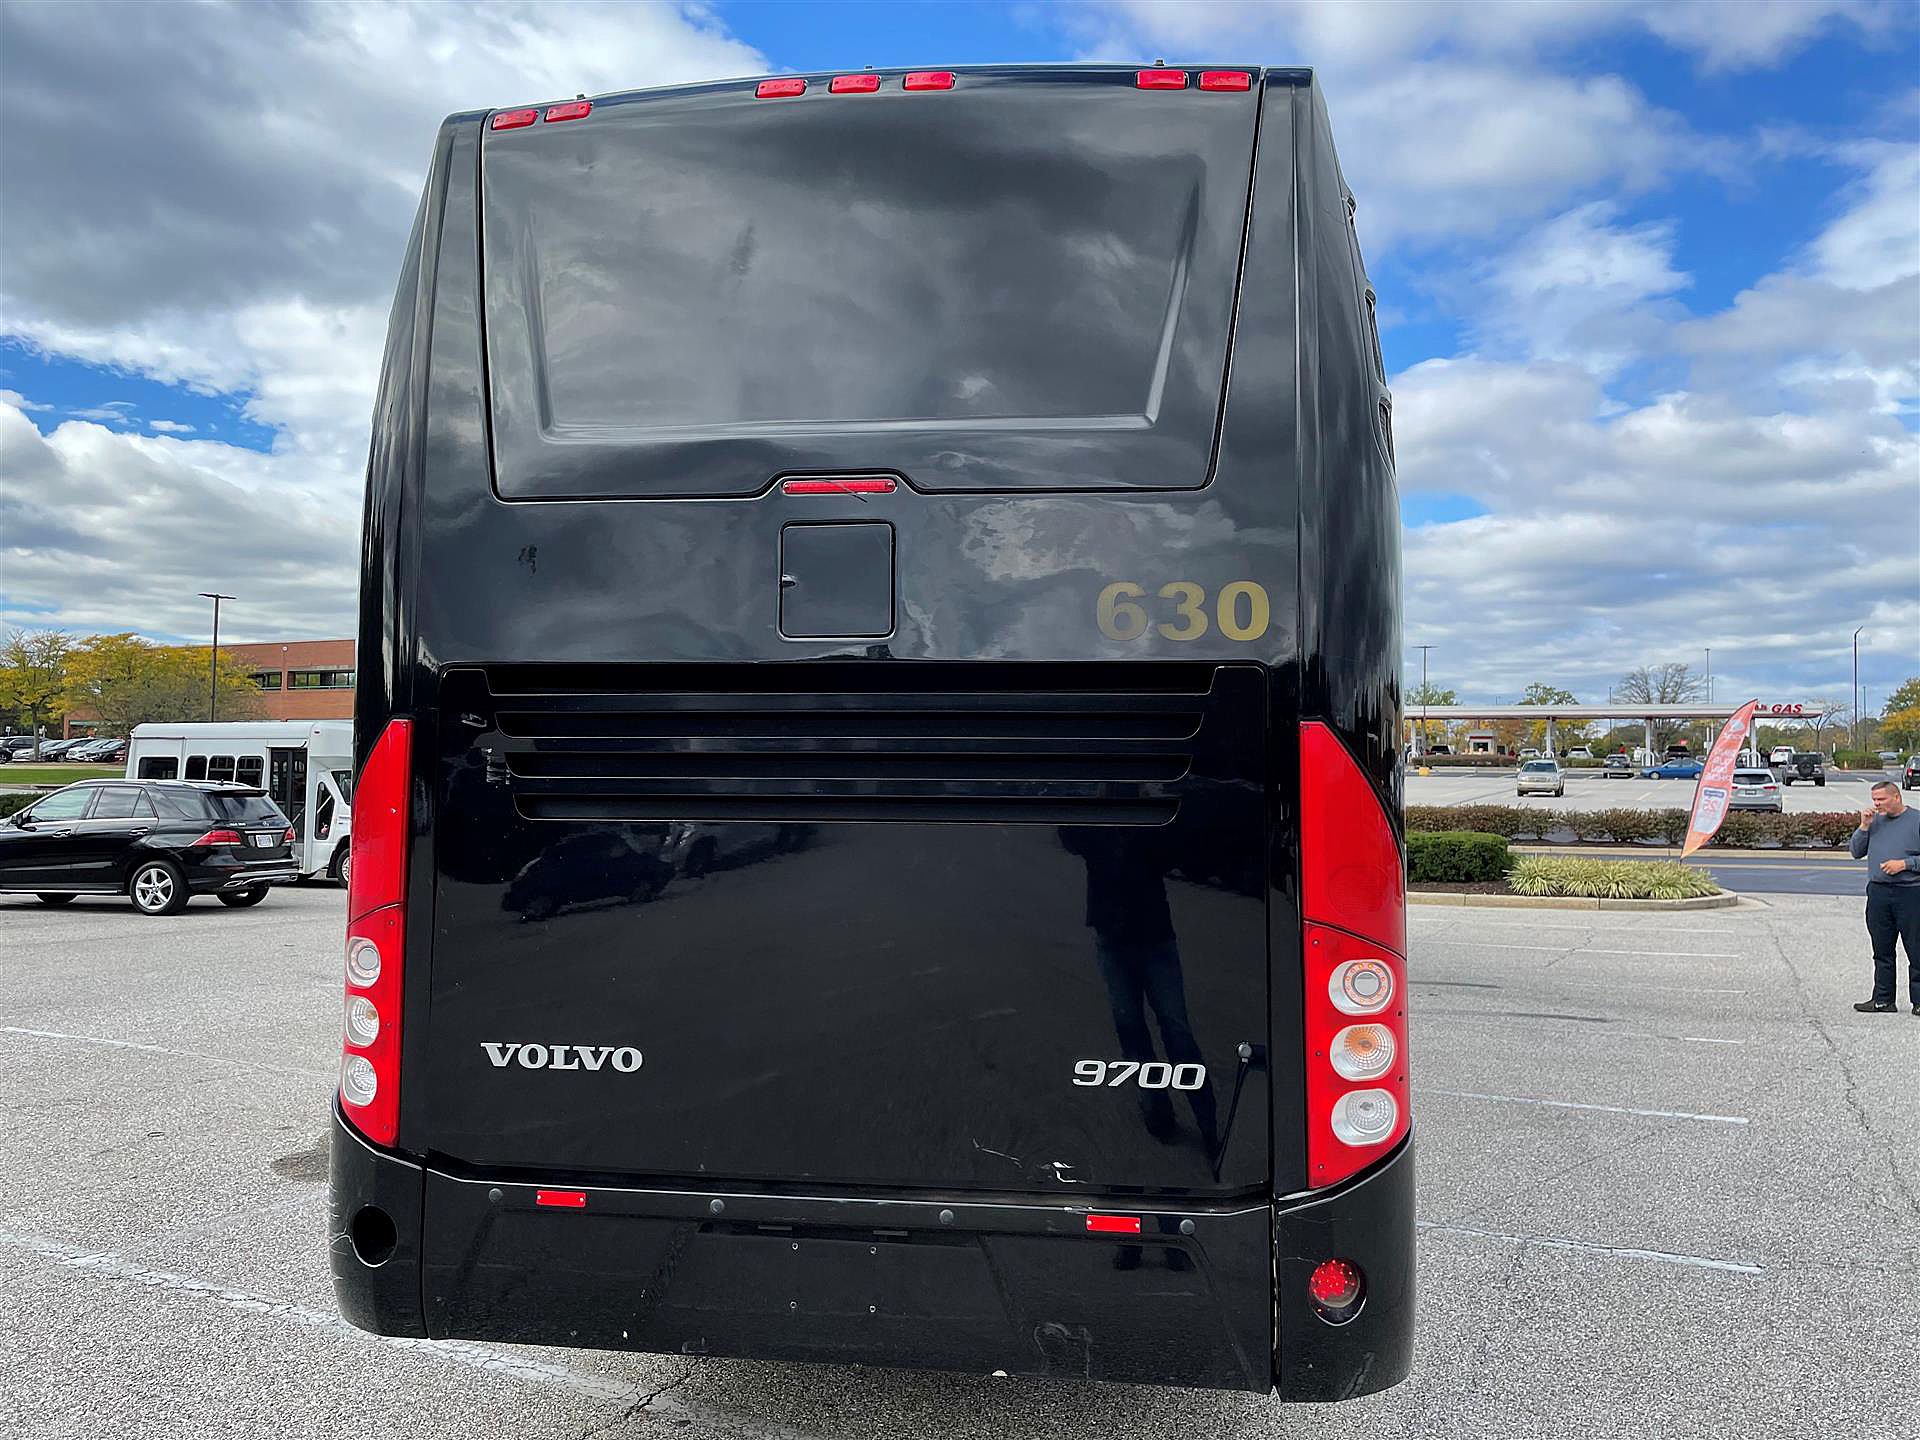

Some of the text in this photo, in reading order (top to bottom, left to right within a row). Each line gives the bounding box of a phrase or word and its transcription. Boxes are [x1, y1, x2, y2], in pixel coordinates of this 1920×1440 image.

[1096, 581, 1270, 641] 630
[1771, 703, 1803, 714] GAS
[480, 1042, 643, 1073] VOLVO
[1072, 1060, 1206, 1090] 9700
